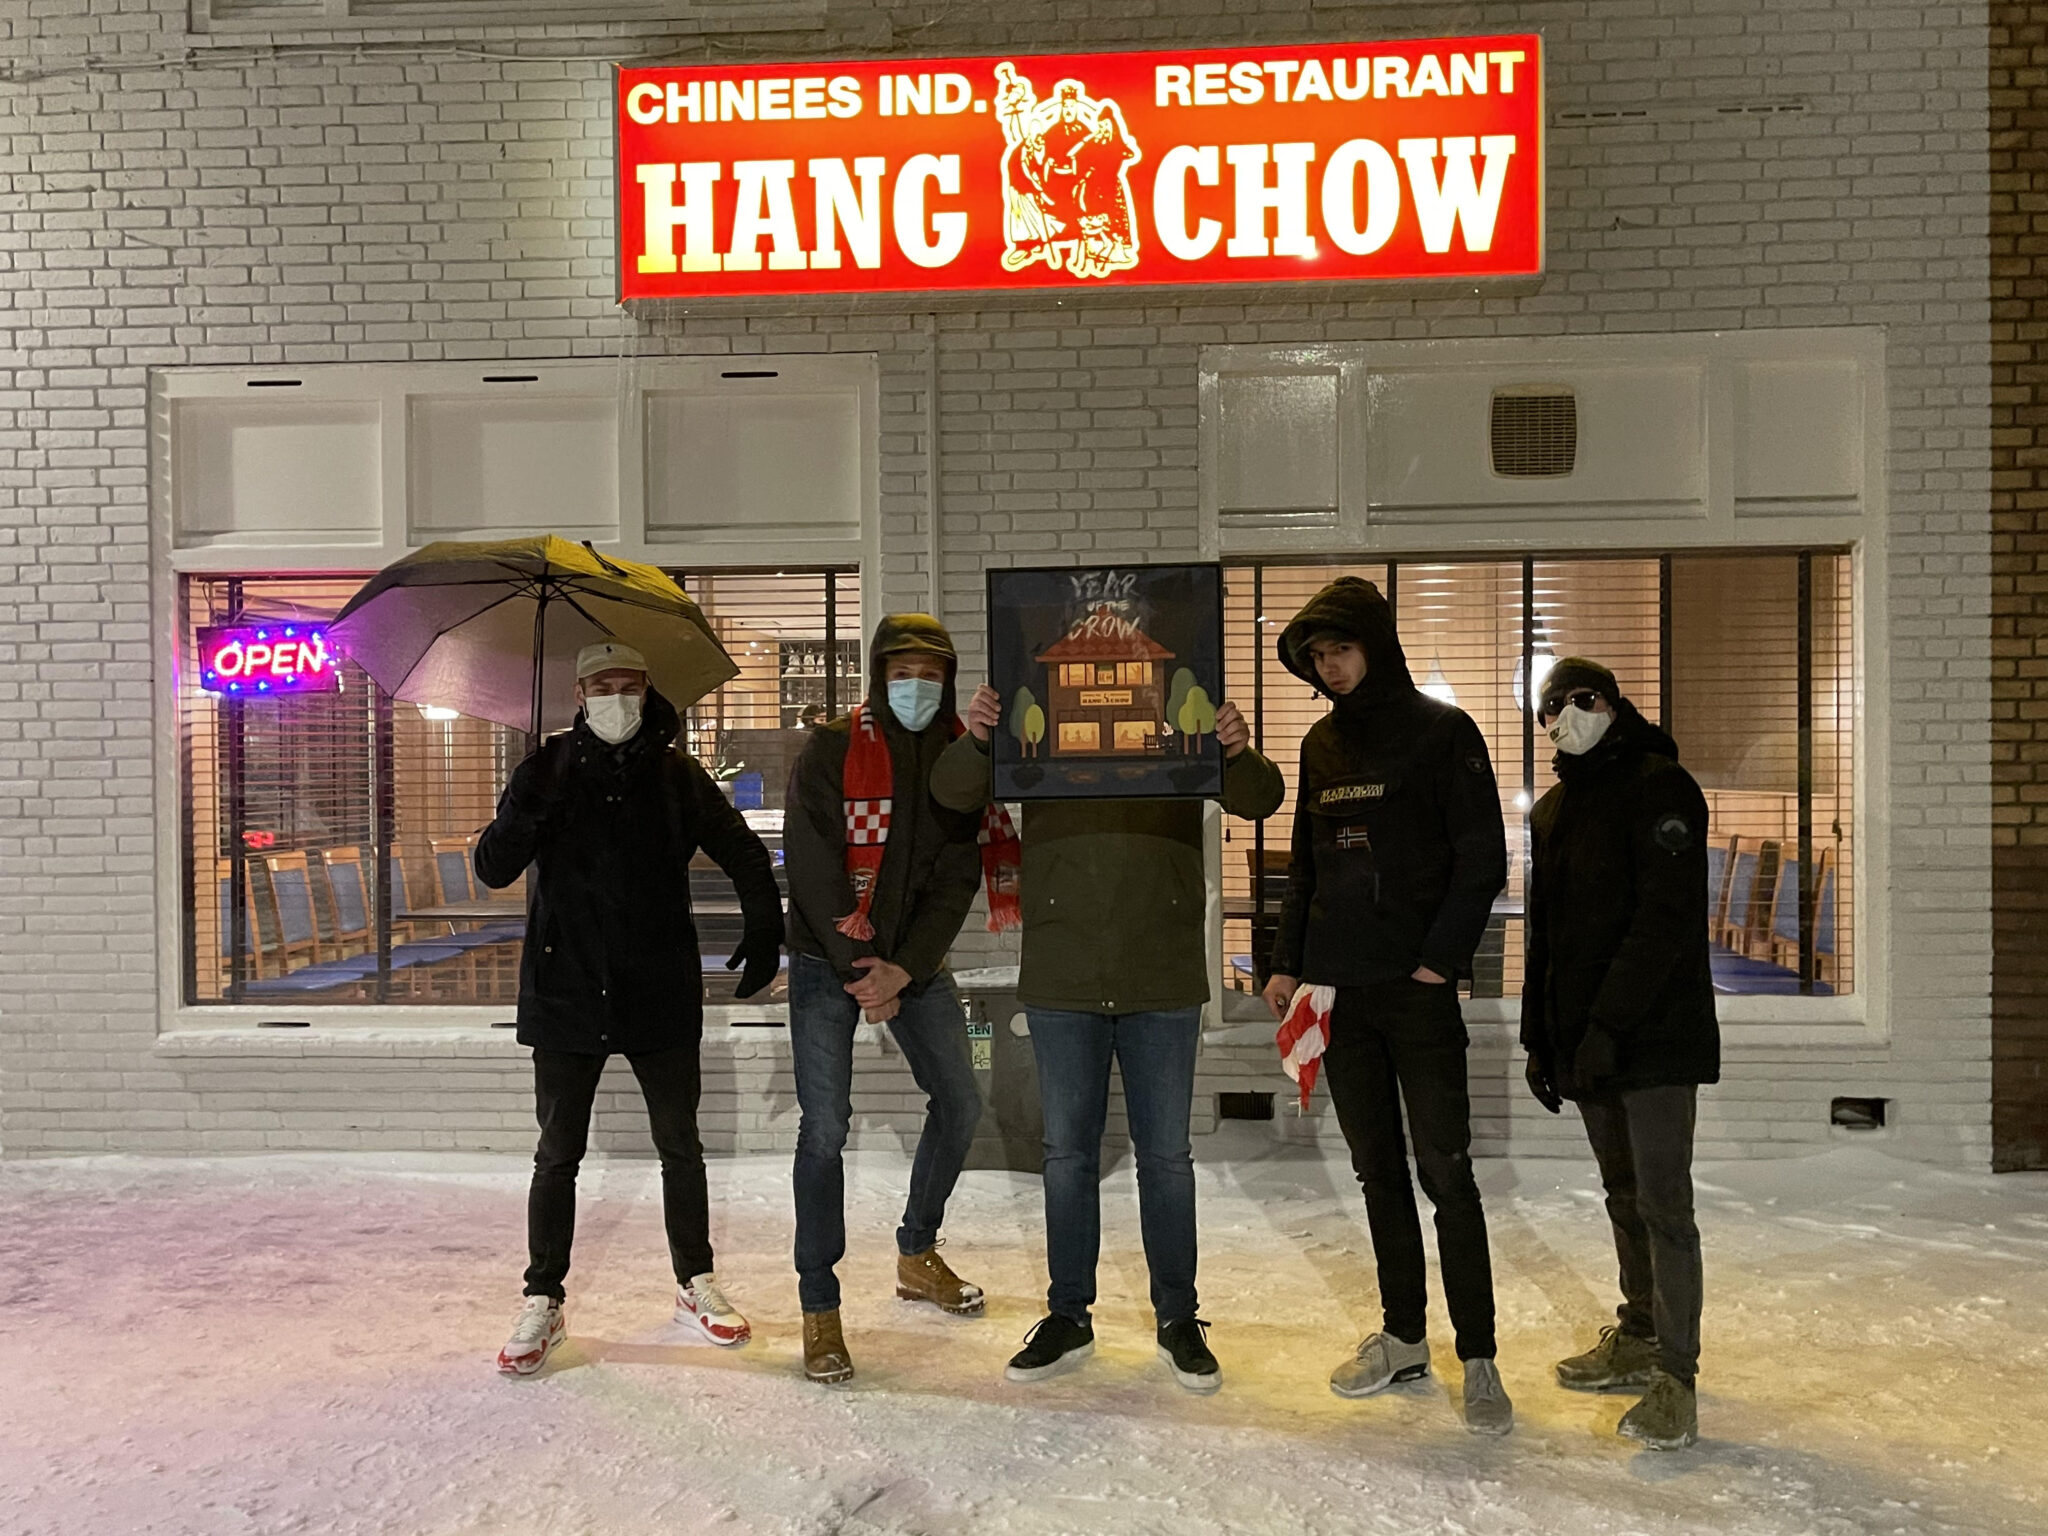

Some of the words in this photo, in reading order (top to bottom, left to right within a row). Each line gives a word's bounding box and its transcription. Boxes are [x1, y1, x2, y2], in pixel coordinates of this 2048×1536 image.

[627, 75, 861, 125] CHINEES
[880, 73, 987, 116] IND.
[1155, 51, 1526, 107] RESTAURANT
[635, 153, 968, 274] HANG
[1152, 135, 1518, 261] CHOW
[1069, 570, 1139, 598] YEAR
[1104, 600, 1130, 611] THE
[215, 643, 323, 676] OPEN
